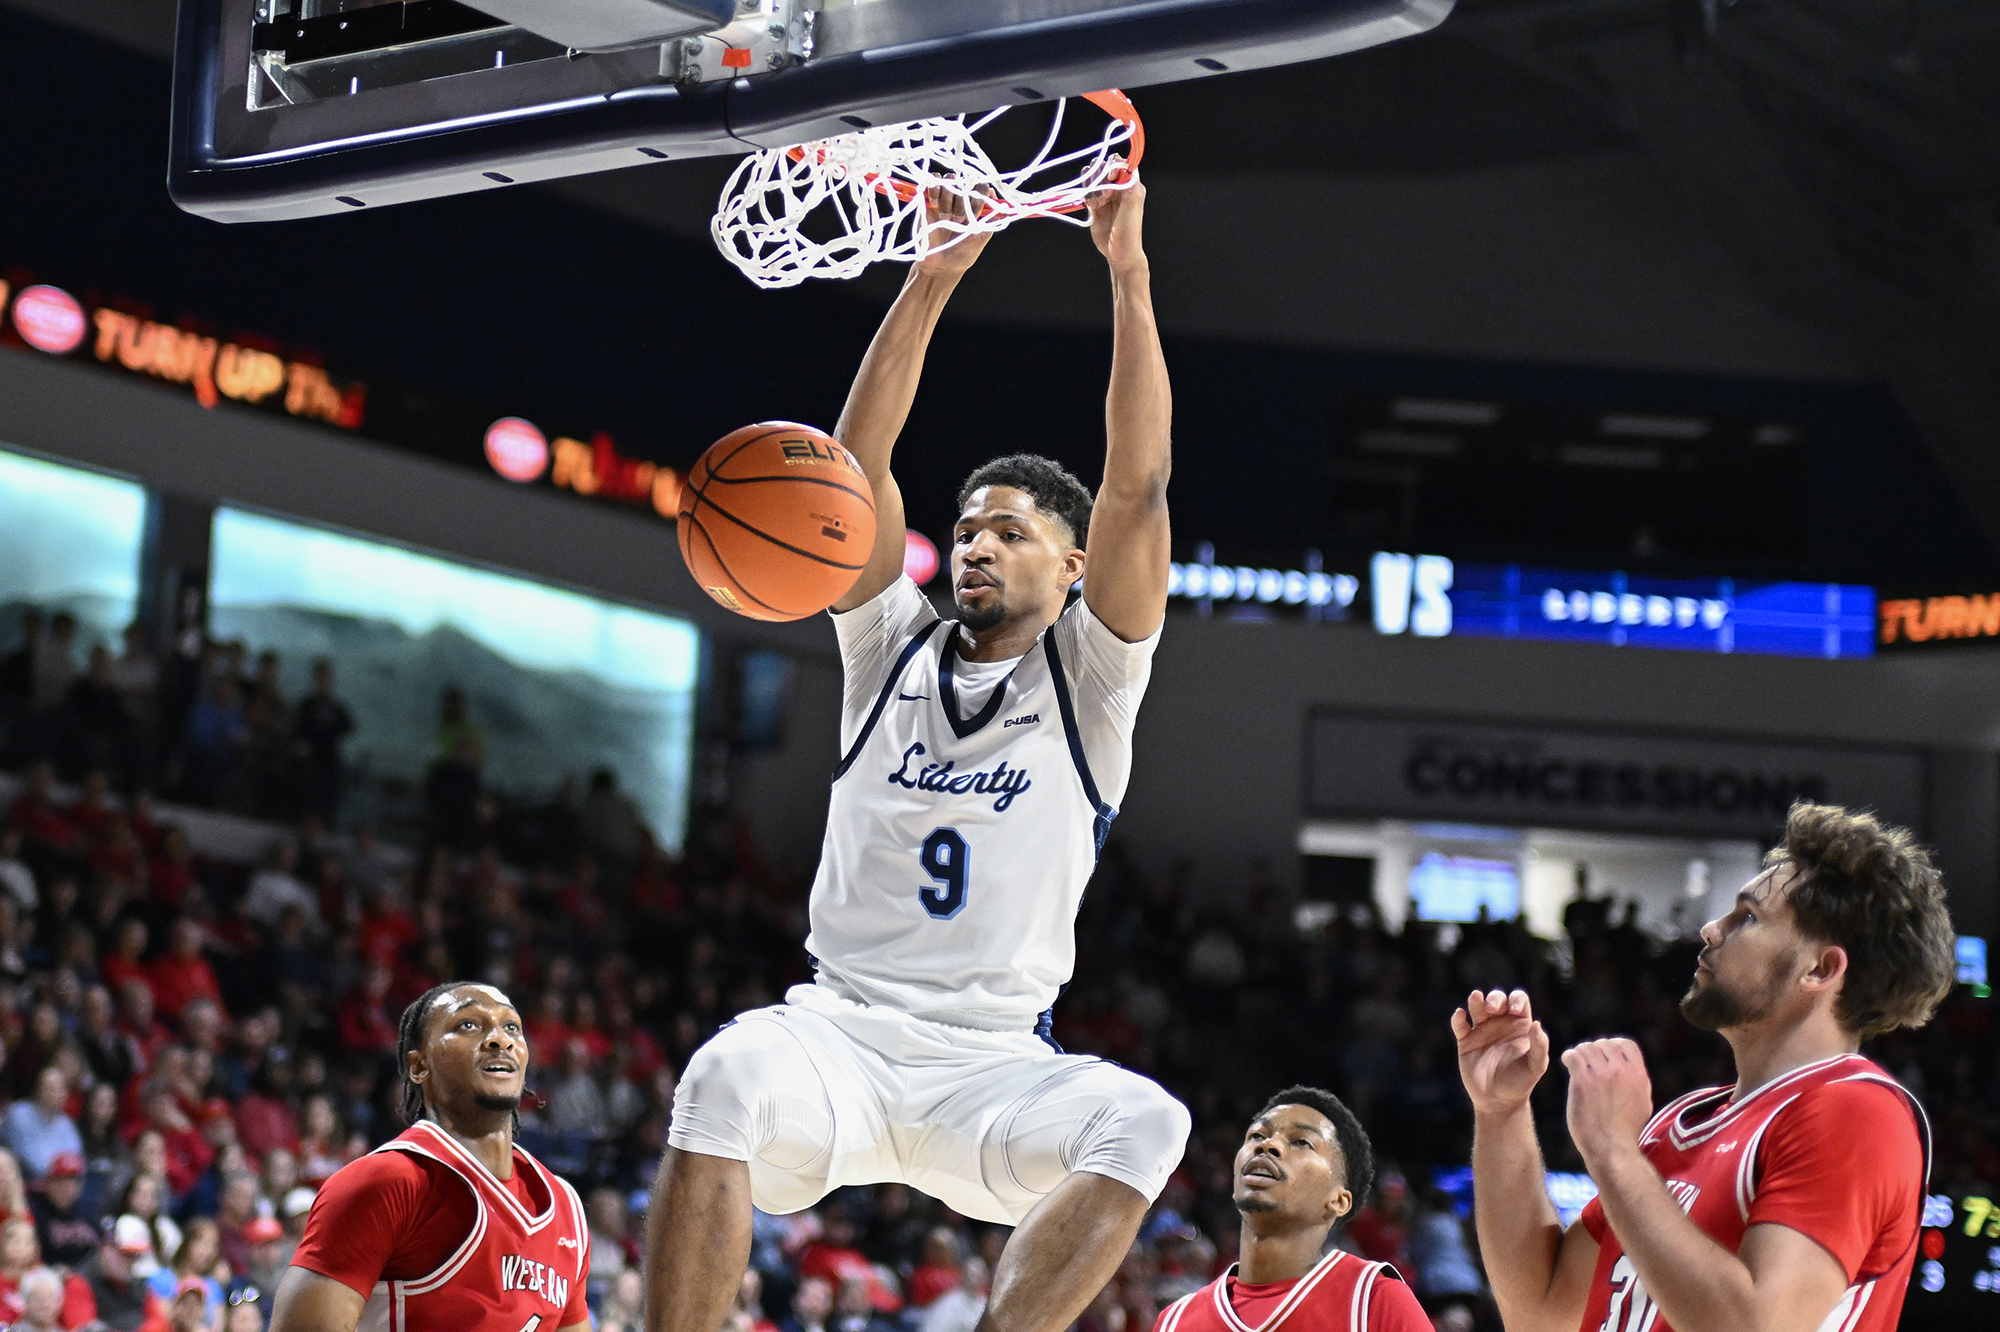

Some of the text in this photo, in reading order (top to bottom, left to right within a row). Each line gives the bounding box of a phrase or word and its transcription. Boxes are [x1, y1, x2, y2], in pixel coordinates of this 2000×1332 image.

[94, 307, 218, 409] TURN
[215, 343, 284, 402] UP
[1370, 550, 1454, 637] VS
[1541, 588, 1728, 630] LIBERTY
[1880, 592, 2000, 643] TURN
[887, 741, 1032, 813] Liberty
[1405, 751, 1828, 810] CONCESSIONS
[917, 826, 972, 921] 9
